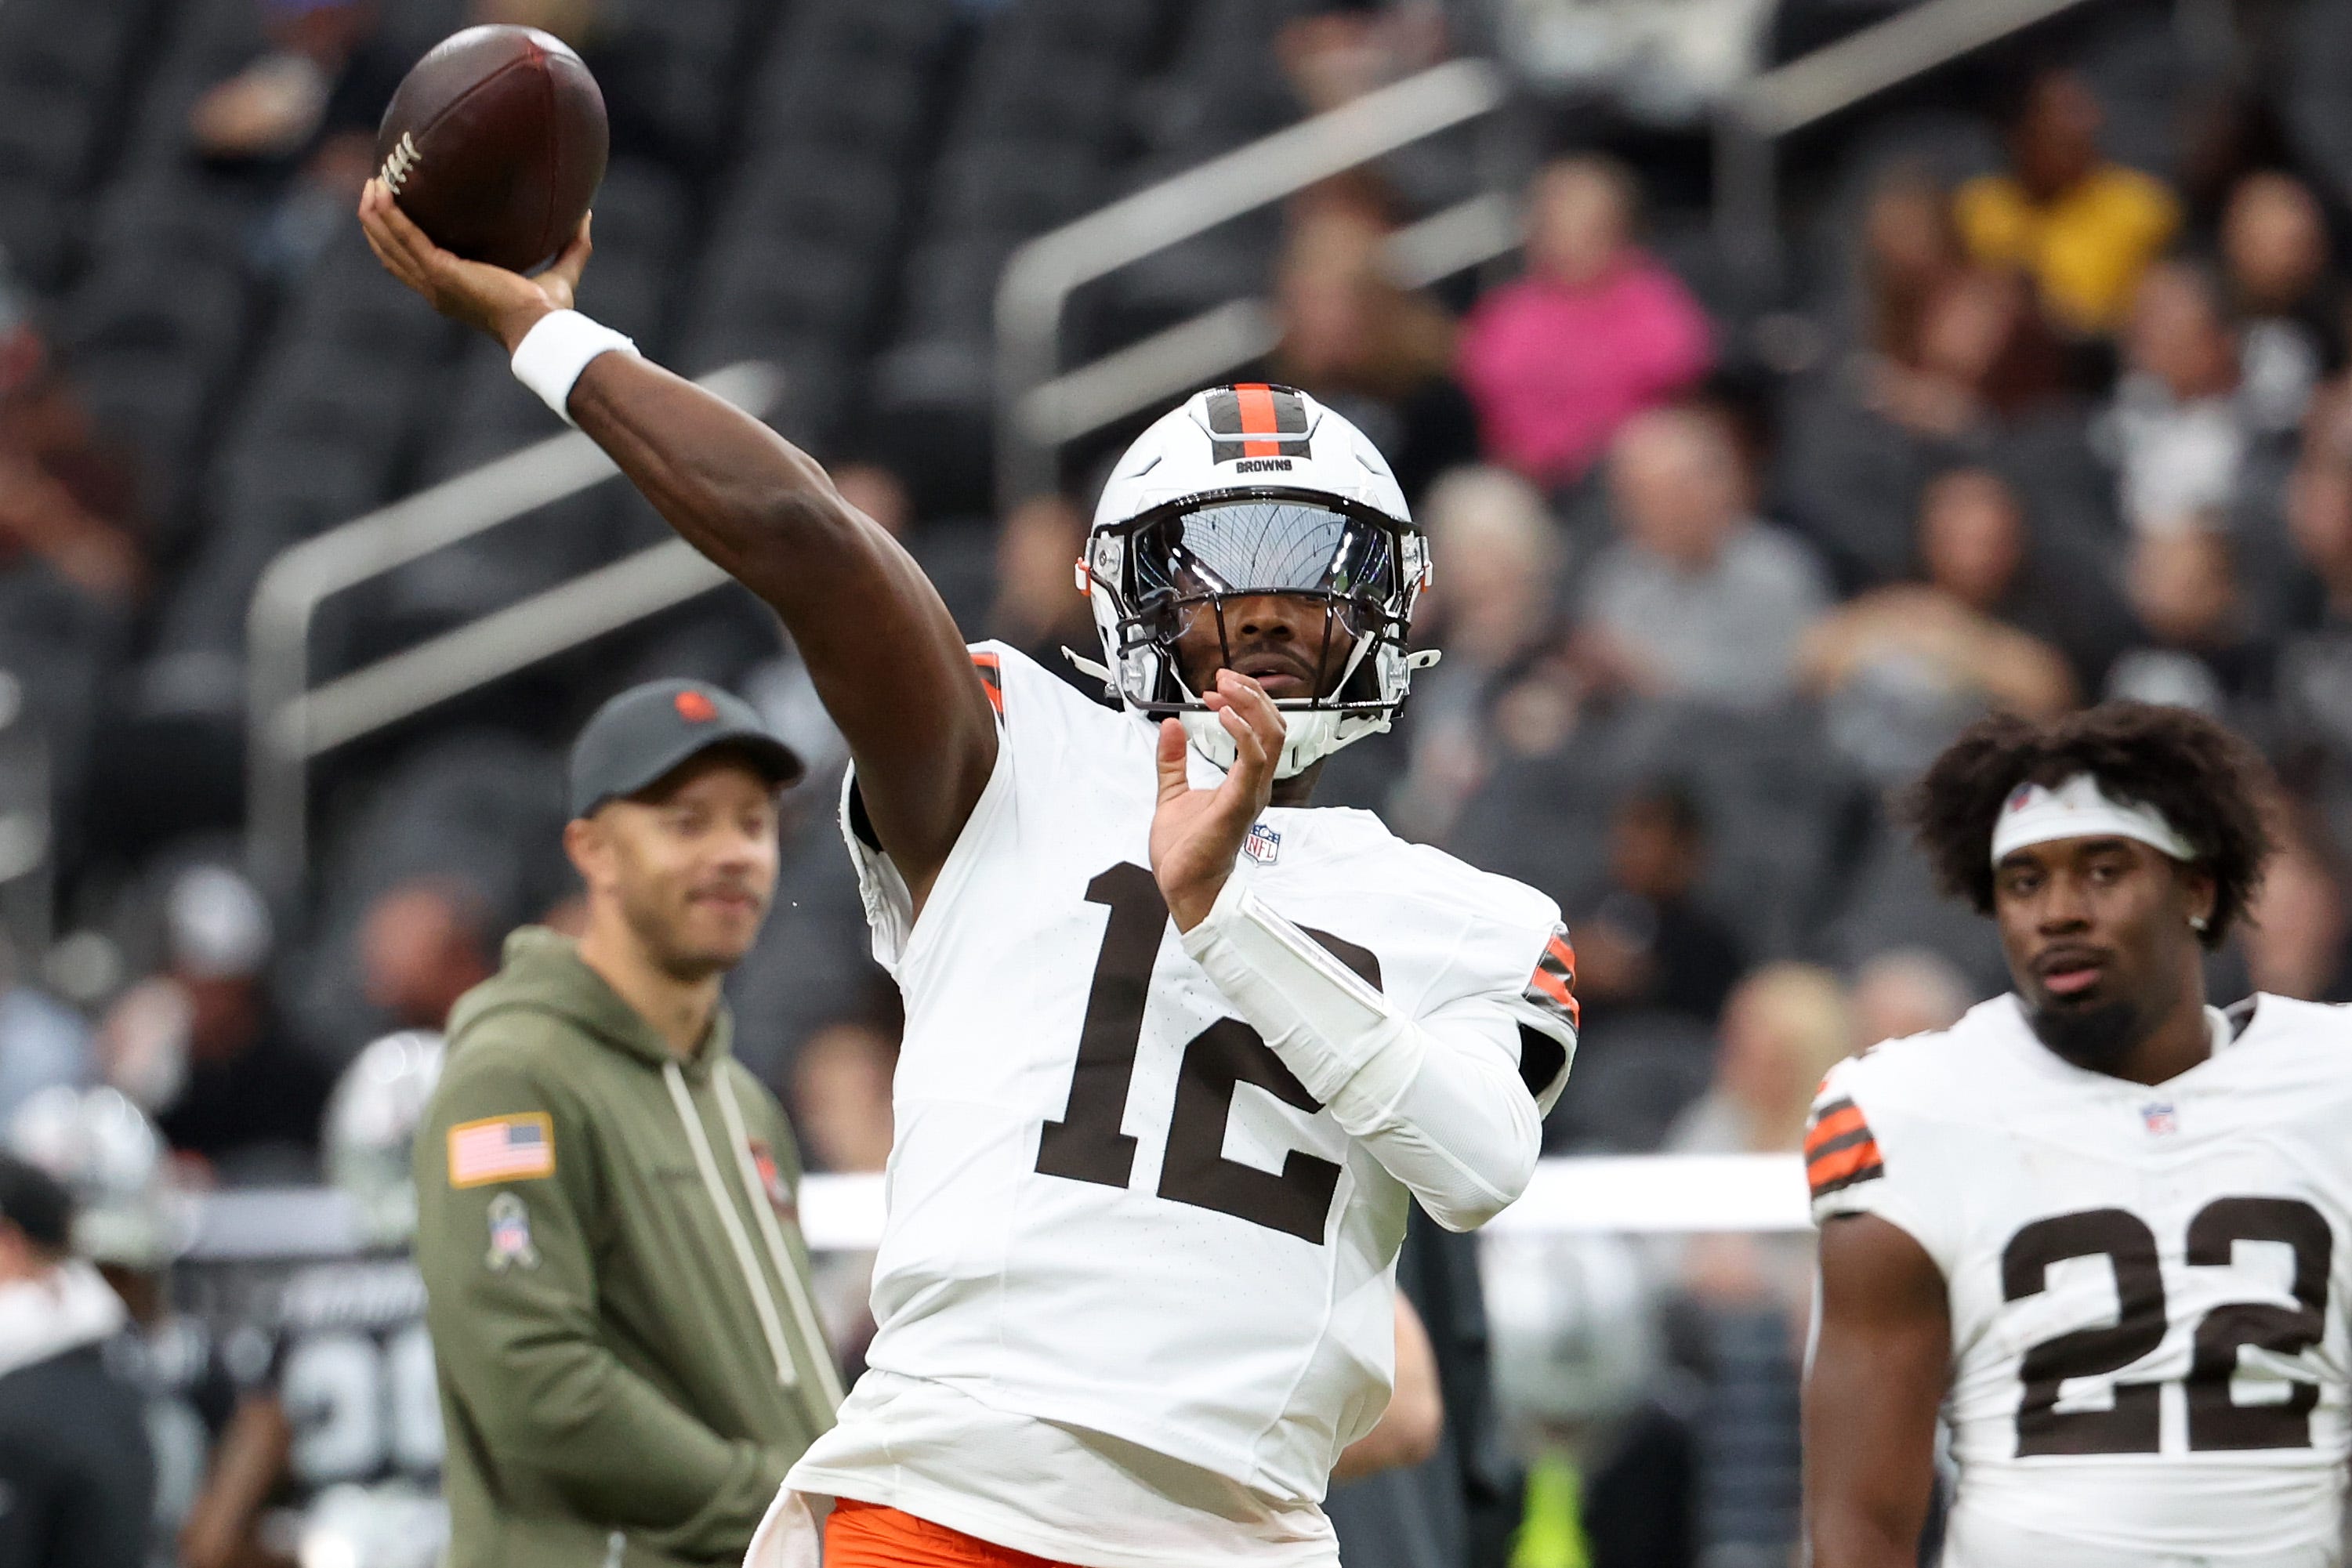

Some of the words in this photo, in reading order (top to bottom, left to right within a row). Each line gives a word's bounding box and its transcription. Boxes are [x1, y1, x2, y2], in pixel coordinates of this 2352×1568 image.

[1236, 459, 1292, 473] BROWNS
[1248, 835, 1274, 858] NFL
[1034, 860, 1385, 1247] 12
[2000, 1195, 2333, 1459] 22
